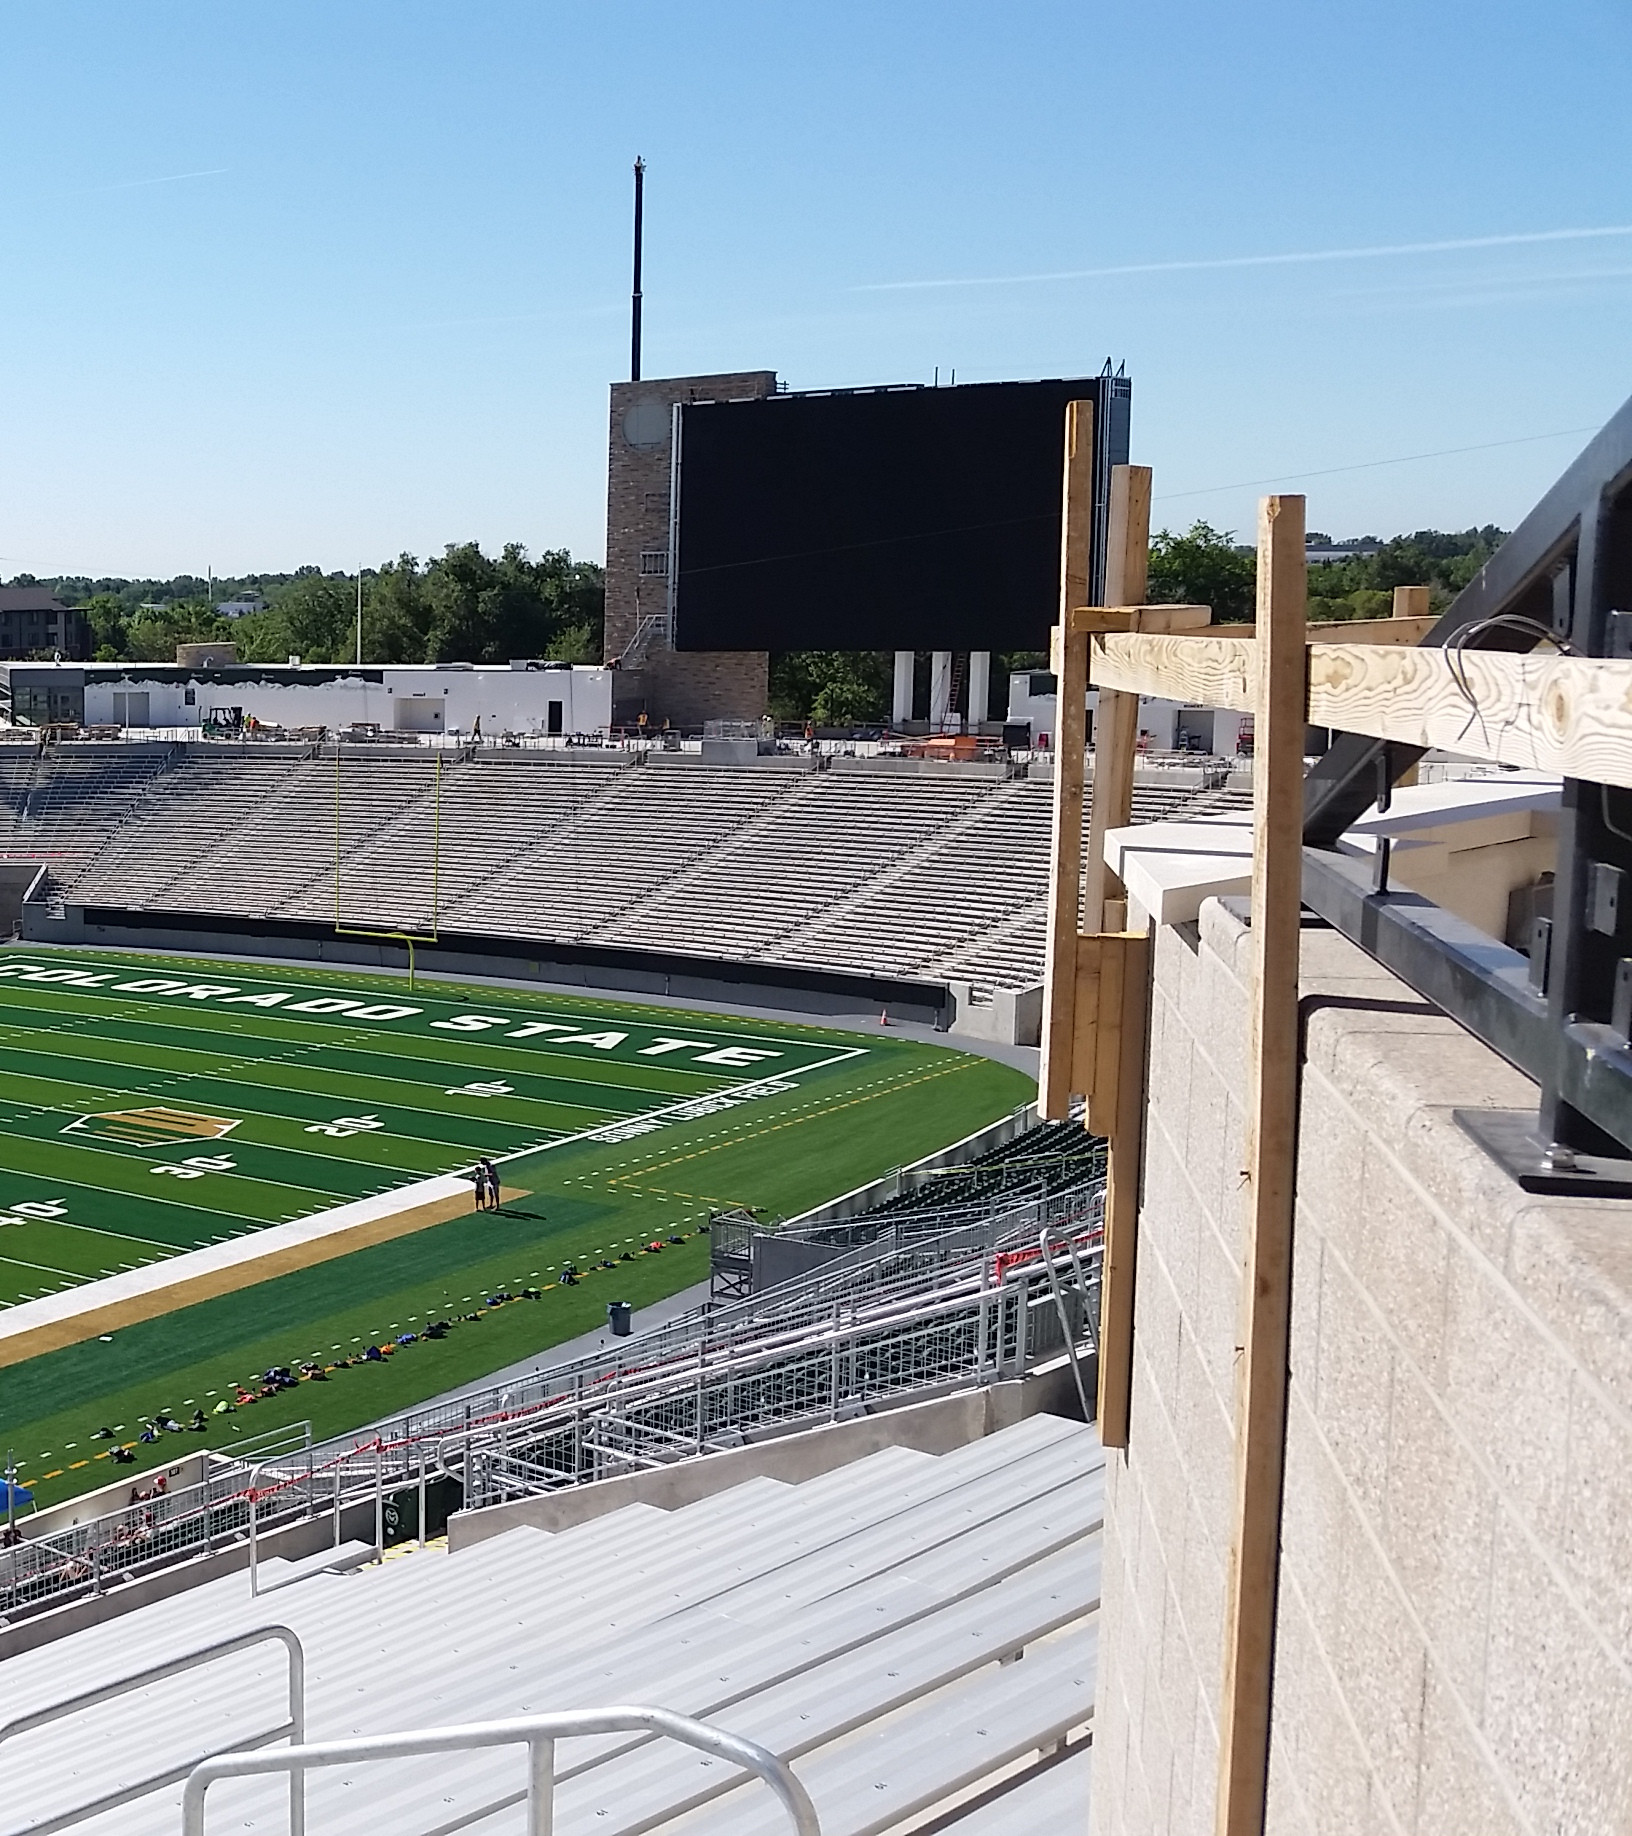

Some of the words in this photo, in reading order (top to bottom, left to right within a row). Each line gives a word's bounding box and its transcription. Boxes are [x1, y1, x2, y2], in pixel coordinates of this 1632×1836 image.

[429, 1015, 785, 1067] STATE
[444, 1082, 515, 1098] 10
[587, 1117, 672, 1144] SONNY
[660, 1096, 747, 1121] LUBICK
[729, 1080, 801, 1100] FIELD
[304, 1116, 385, 1137] 20
[150, 1156, 238, 1179] 30
